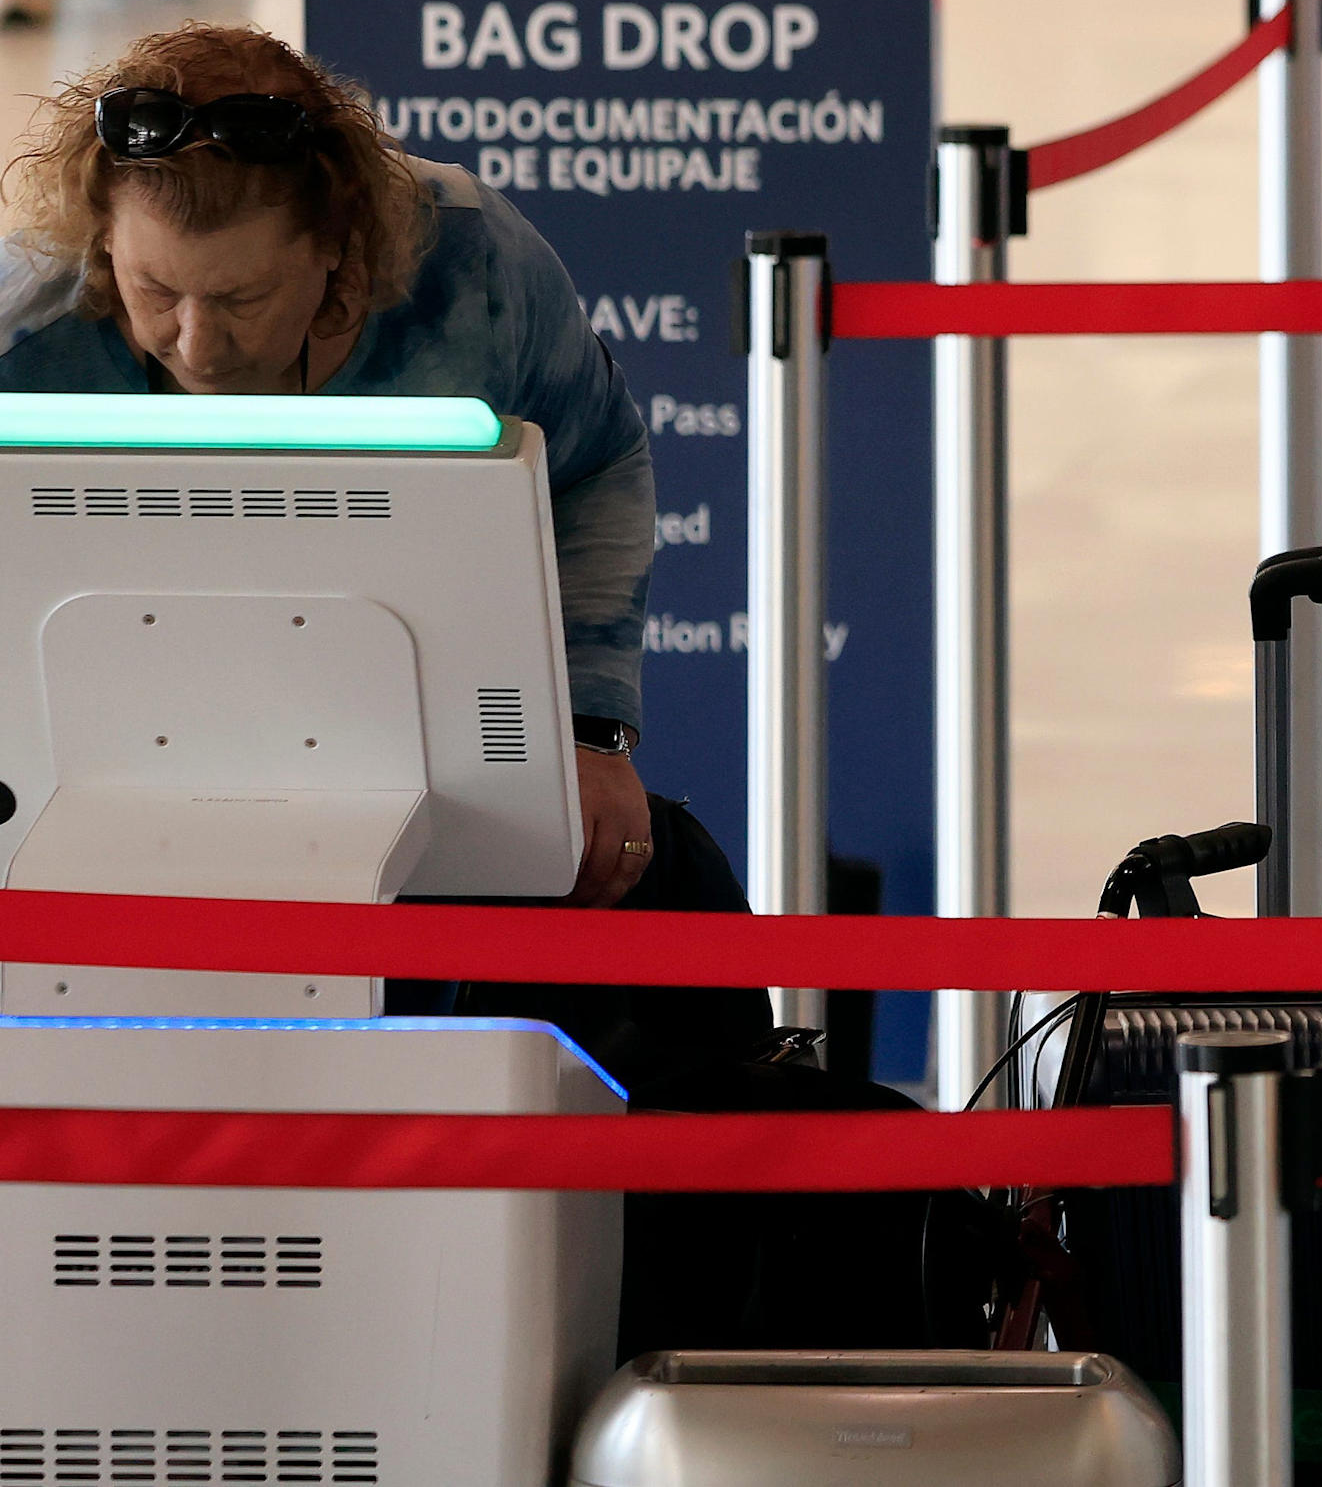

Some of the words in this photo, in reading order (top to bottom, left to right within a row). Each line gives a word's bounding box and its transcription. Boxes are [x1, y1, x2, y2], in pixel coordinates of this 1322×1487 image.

[420, 2, 583, 71] BAG
[602, 3, 820, 71] DROP
[376, 88, 884, 143] UTODOCUMENTACIÓN
[477, 146, 540, 191] DE
[547, 147, 761, 196] EQUIPAJE
[577, 293, 700, 343] AVE:
[650, 394, 742, 438] Pass
